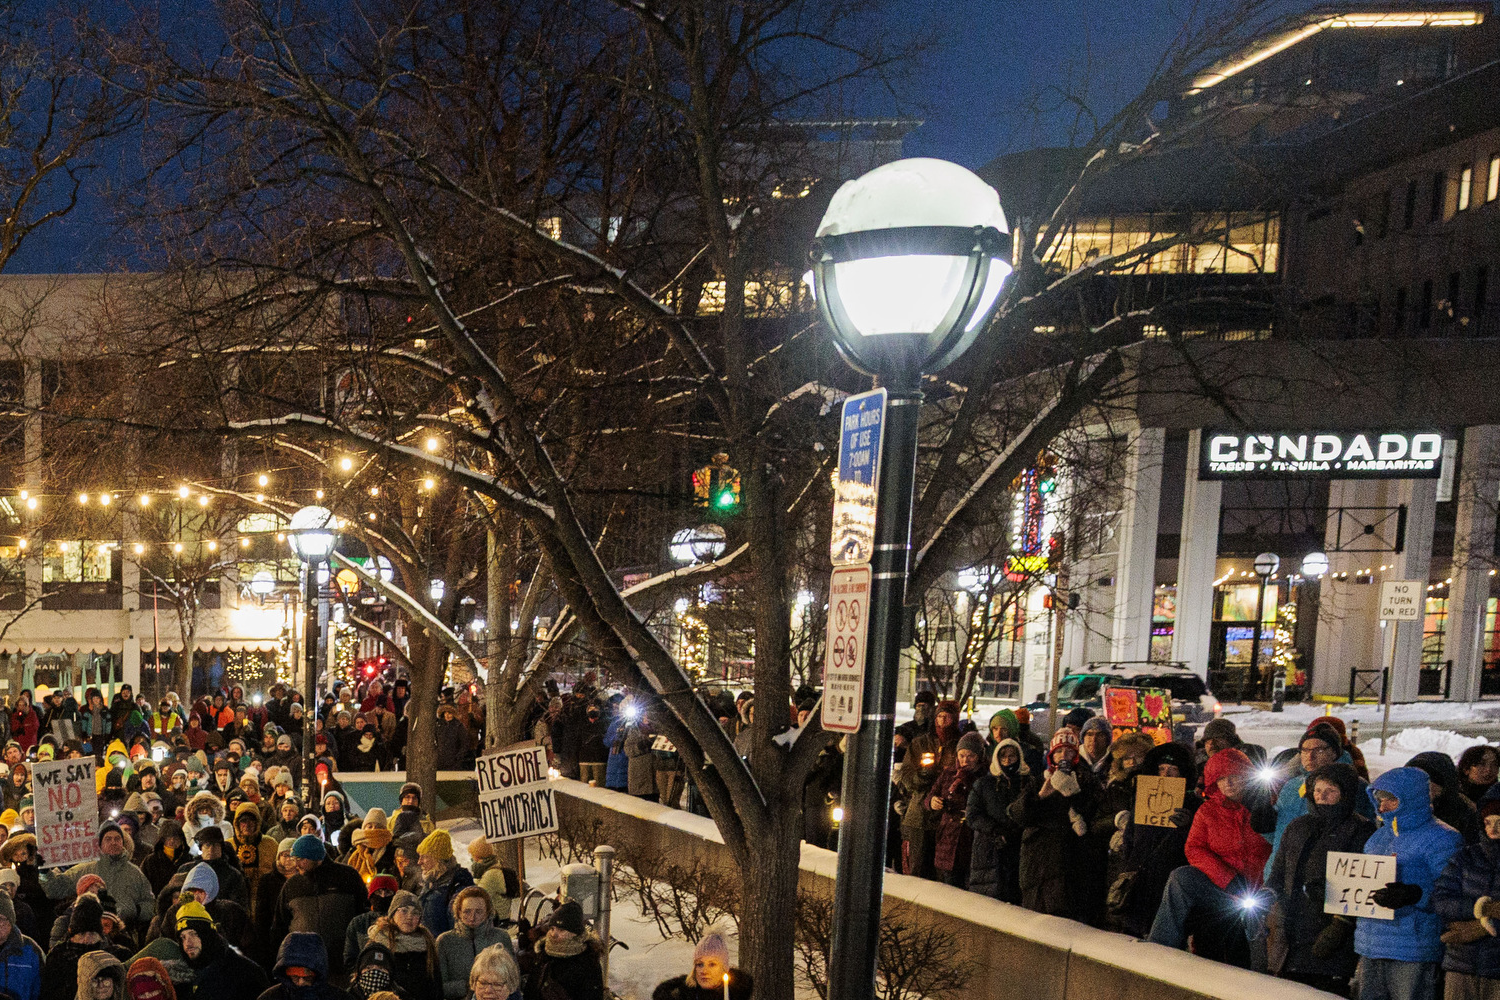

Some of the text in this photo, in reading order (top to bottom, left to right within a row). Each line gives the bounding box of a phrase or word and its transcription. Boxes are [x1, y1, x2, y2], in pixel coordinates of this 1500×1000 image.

[845, 413, 860, 431] PARK
[1210, 433, 1442, 462] CONDADO
[1209, 460, 1434, 472] TACOS TEQUILA MARGARITAS
[1395, 585, 1409, 594] NO
[1382, 607, 1416, 616] ON RED
[1390, 597, 1413, 605] TURN
[36, 763, 92, 787] WE SAY
[477, 750, 546, 791] RESTORE
[47, 782, 82, 812] NO
[56, 811, 74, 822] TO
[481, 789, 554, 839] DEMOCRACY
[42, 818, 95, 844] STATE
[39, 838, 100, 863] TERROR
[1334, 858, 1385, 879] MELT
[1339, 887, 1377, 906] ICE
